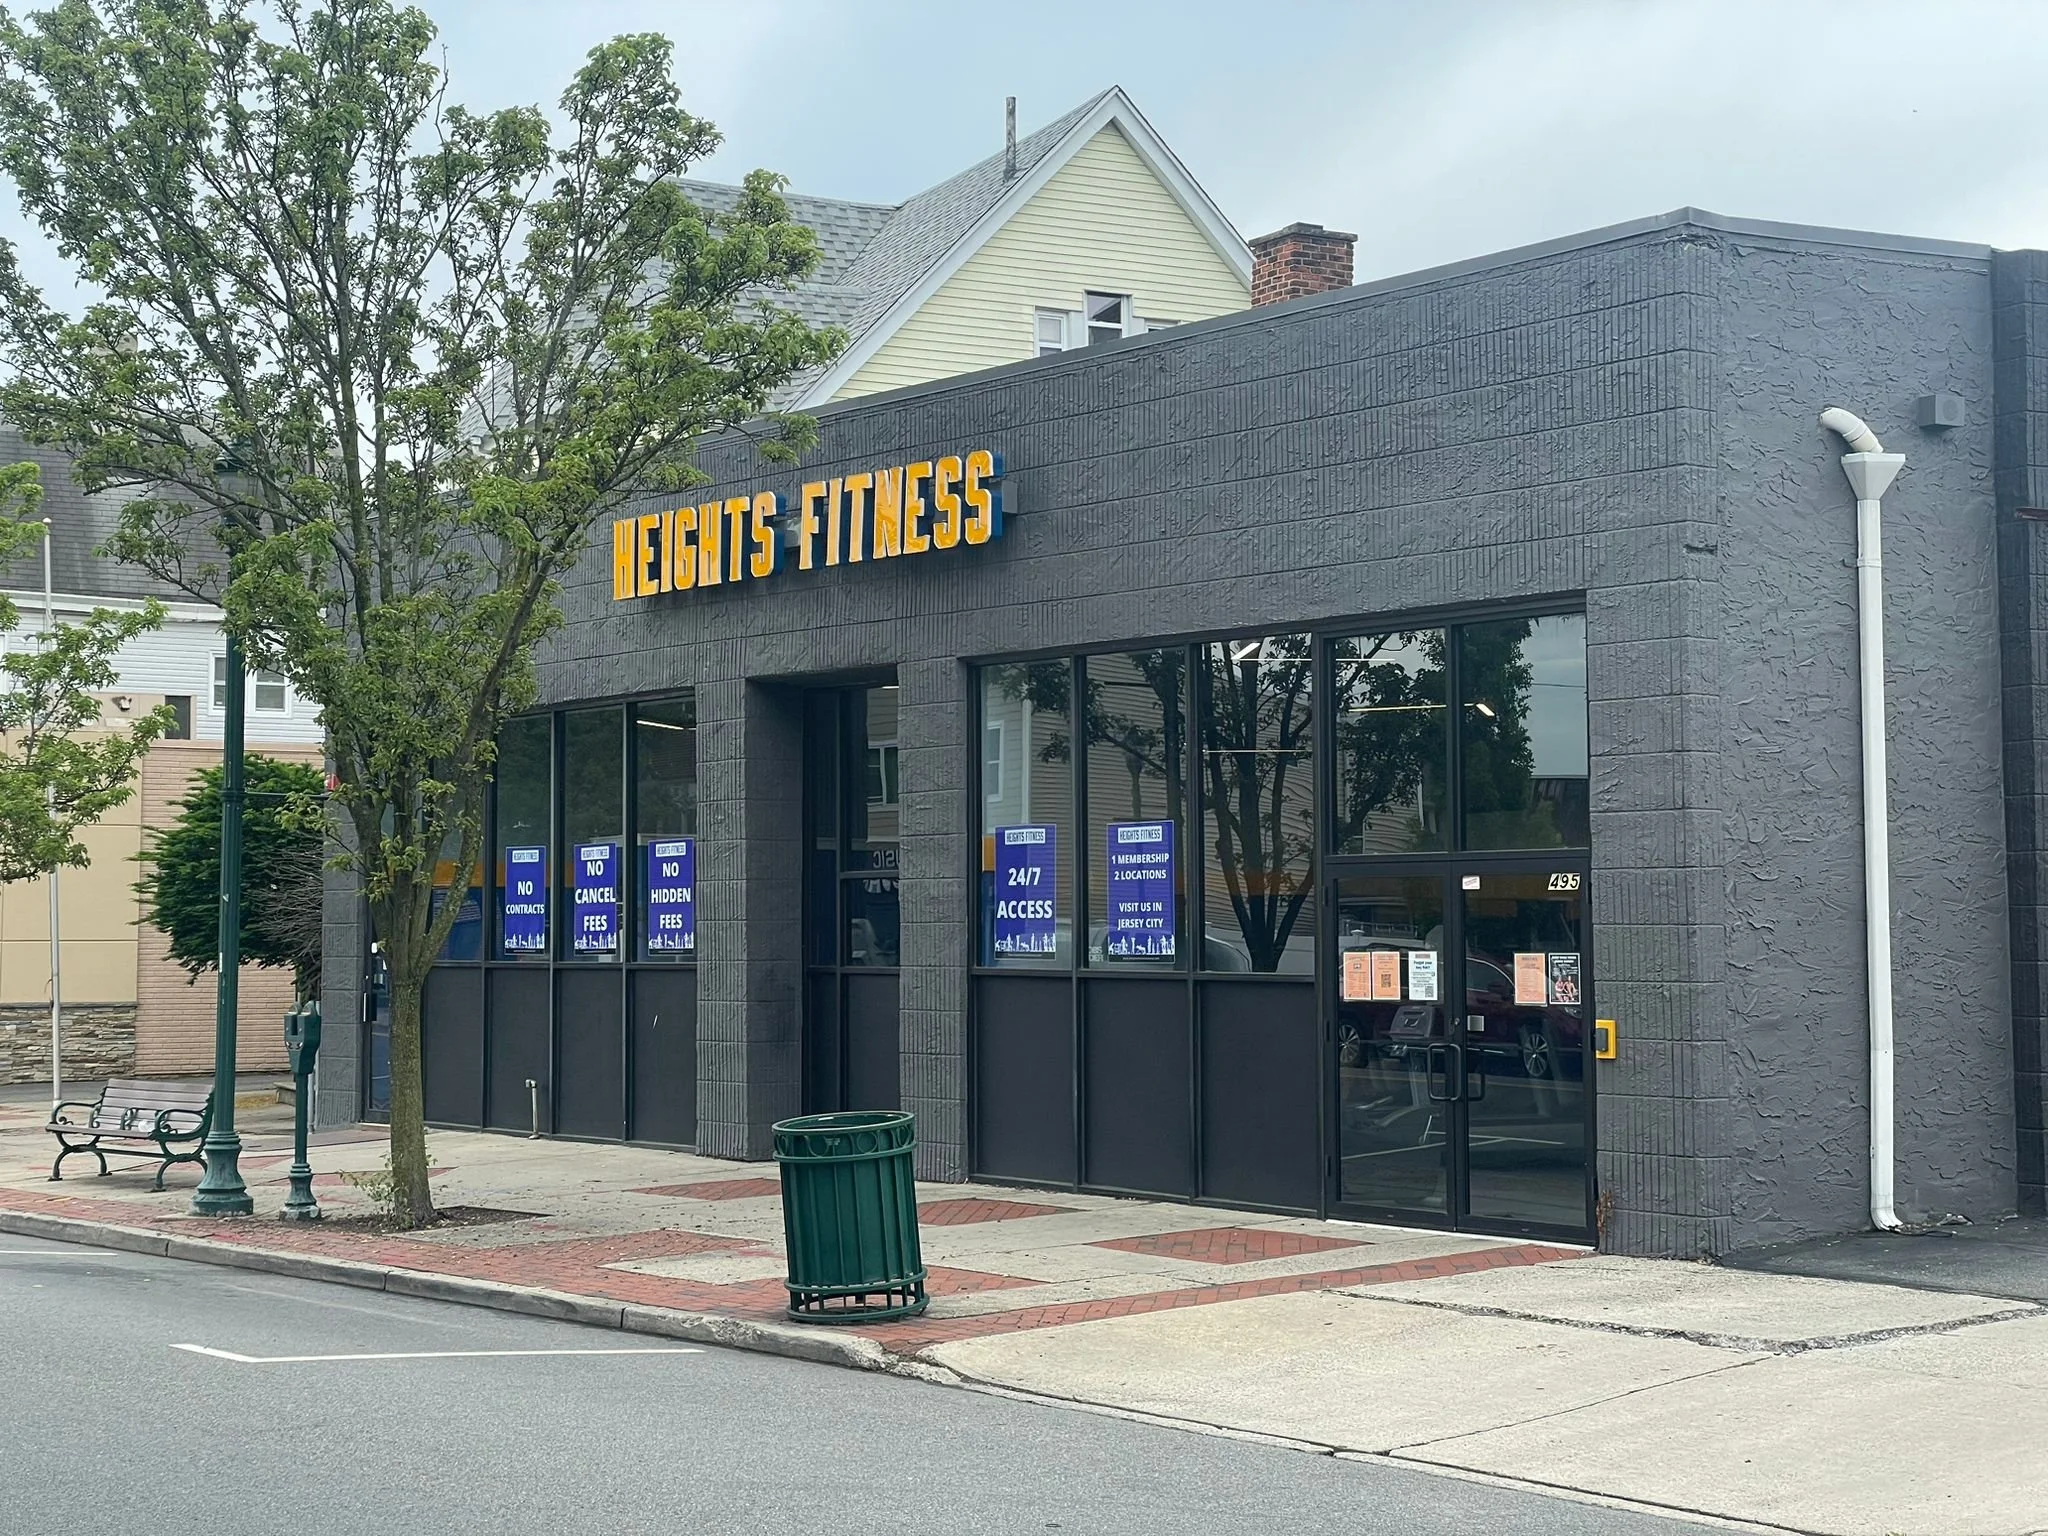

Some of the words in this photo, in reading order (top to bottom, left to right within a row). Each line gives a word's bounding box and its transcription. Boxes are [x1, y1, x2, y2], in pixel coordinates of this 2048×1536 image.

[613, 490, 777, 600] HEIGHTS
[799, 450, 994, 570] FITNESS
[1112, 856, 1116, 864] 1
[1118, 853, 1170, 864] MEMBERSHIP
[586, 860, 604, 876] NO
[662, 862, 679, 877] NO
[1114, 871, 1121, 880] 2
[1122, 869, 1166, 880] LOCATIONS
[1007, 867, 1041, 886] 24/7
[1551, 874, 1580, 889] 495
[517, 880, 533, 896] NO
[575, 887, 616, 904] CANCEL
[651, 887, 691, 904] HIDDEN
[506, 904, 545, 915] CONTRACTS
[996, 900, 1053, 919] ACCESS
[1119, 902, 1139, 912] VISIT
[1140, 902, 1152, 912] US
[1152, 902, 1162, 911] IN
[583, 915, 608, 932] FEES
[659, 914, 683, 929] FEES
[1118, 919, 1144, 930] JERSEY
[1146, 918, 1164, 928] CITY
